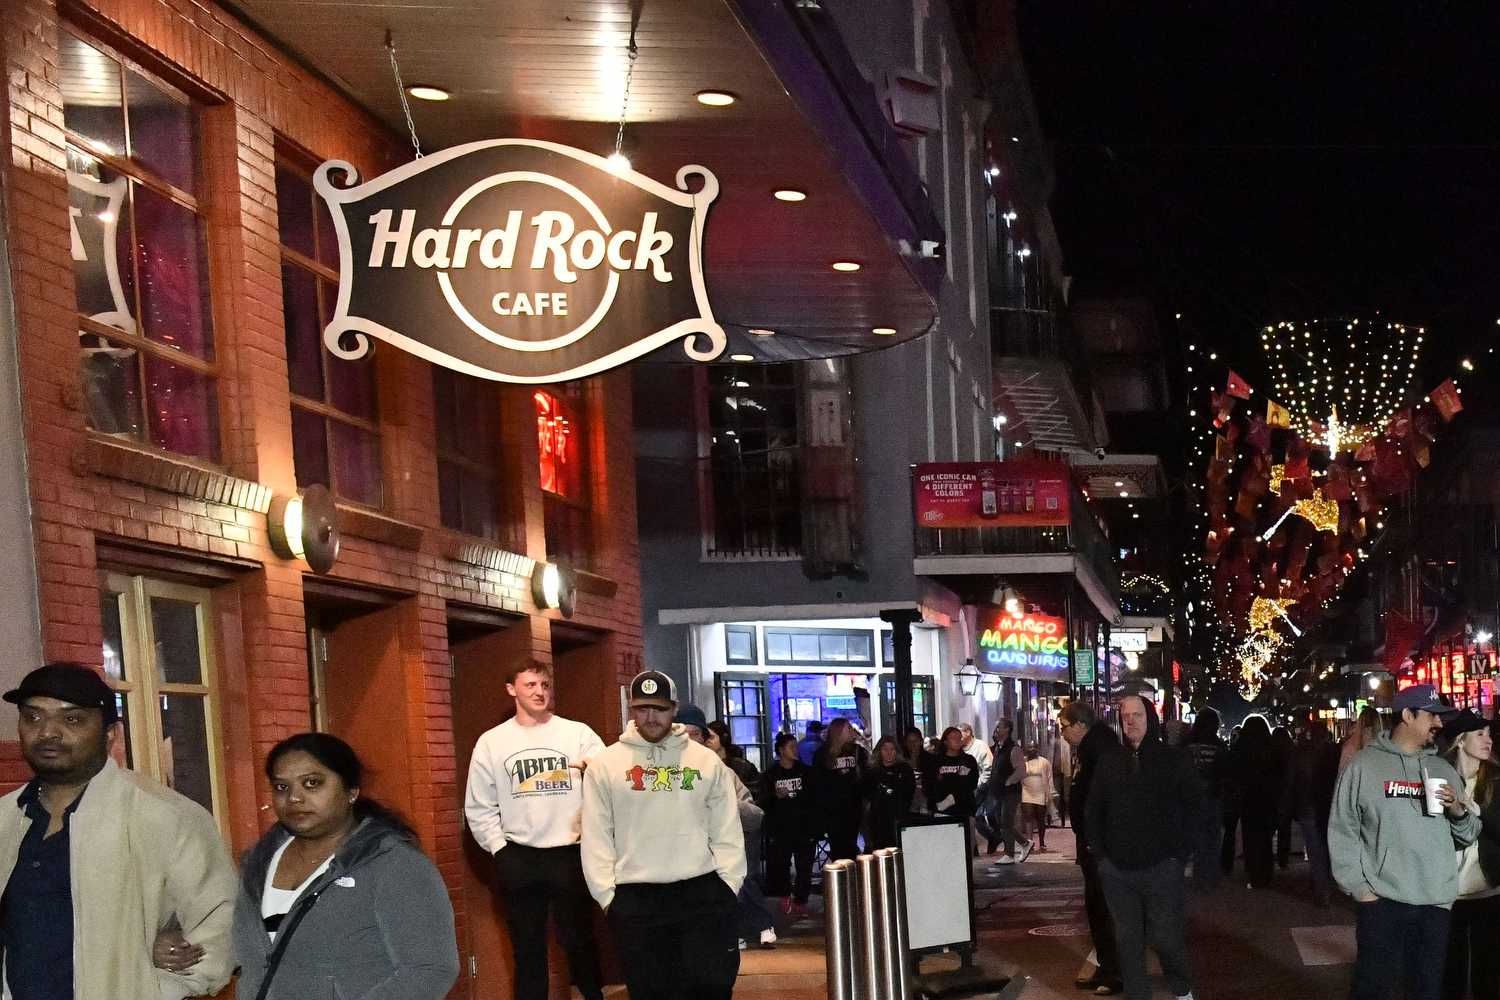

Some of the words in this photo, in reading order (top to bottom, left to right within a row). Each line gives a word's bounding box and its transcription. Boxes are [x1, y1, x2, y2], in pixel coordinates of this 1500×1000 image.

[368, 209, 523, 269] Hard
[530, 211, 674, 283] Rock
[491, 292, 568, 316] CAFE
[980, 628, 1078, 656] MANGO
[987, 649, 1069, 668] DAIQUIRIS
[511, 756, 567, 784] ABITA
[536, 780, 569, 790] BEER
